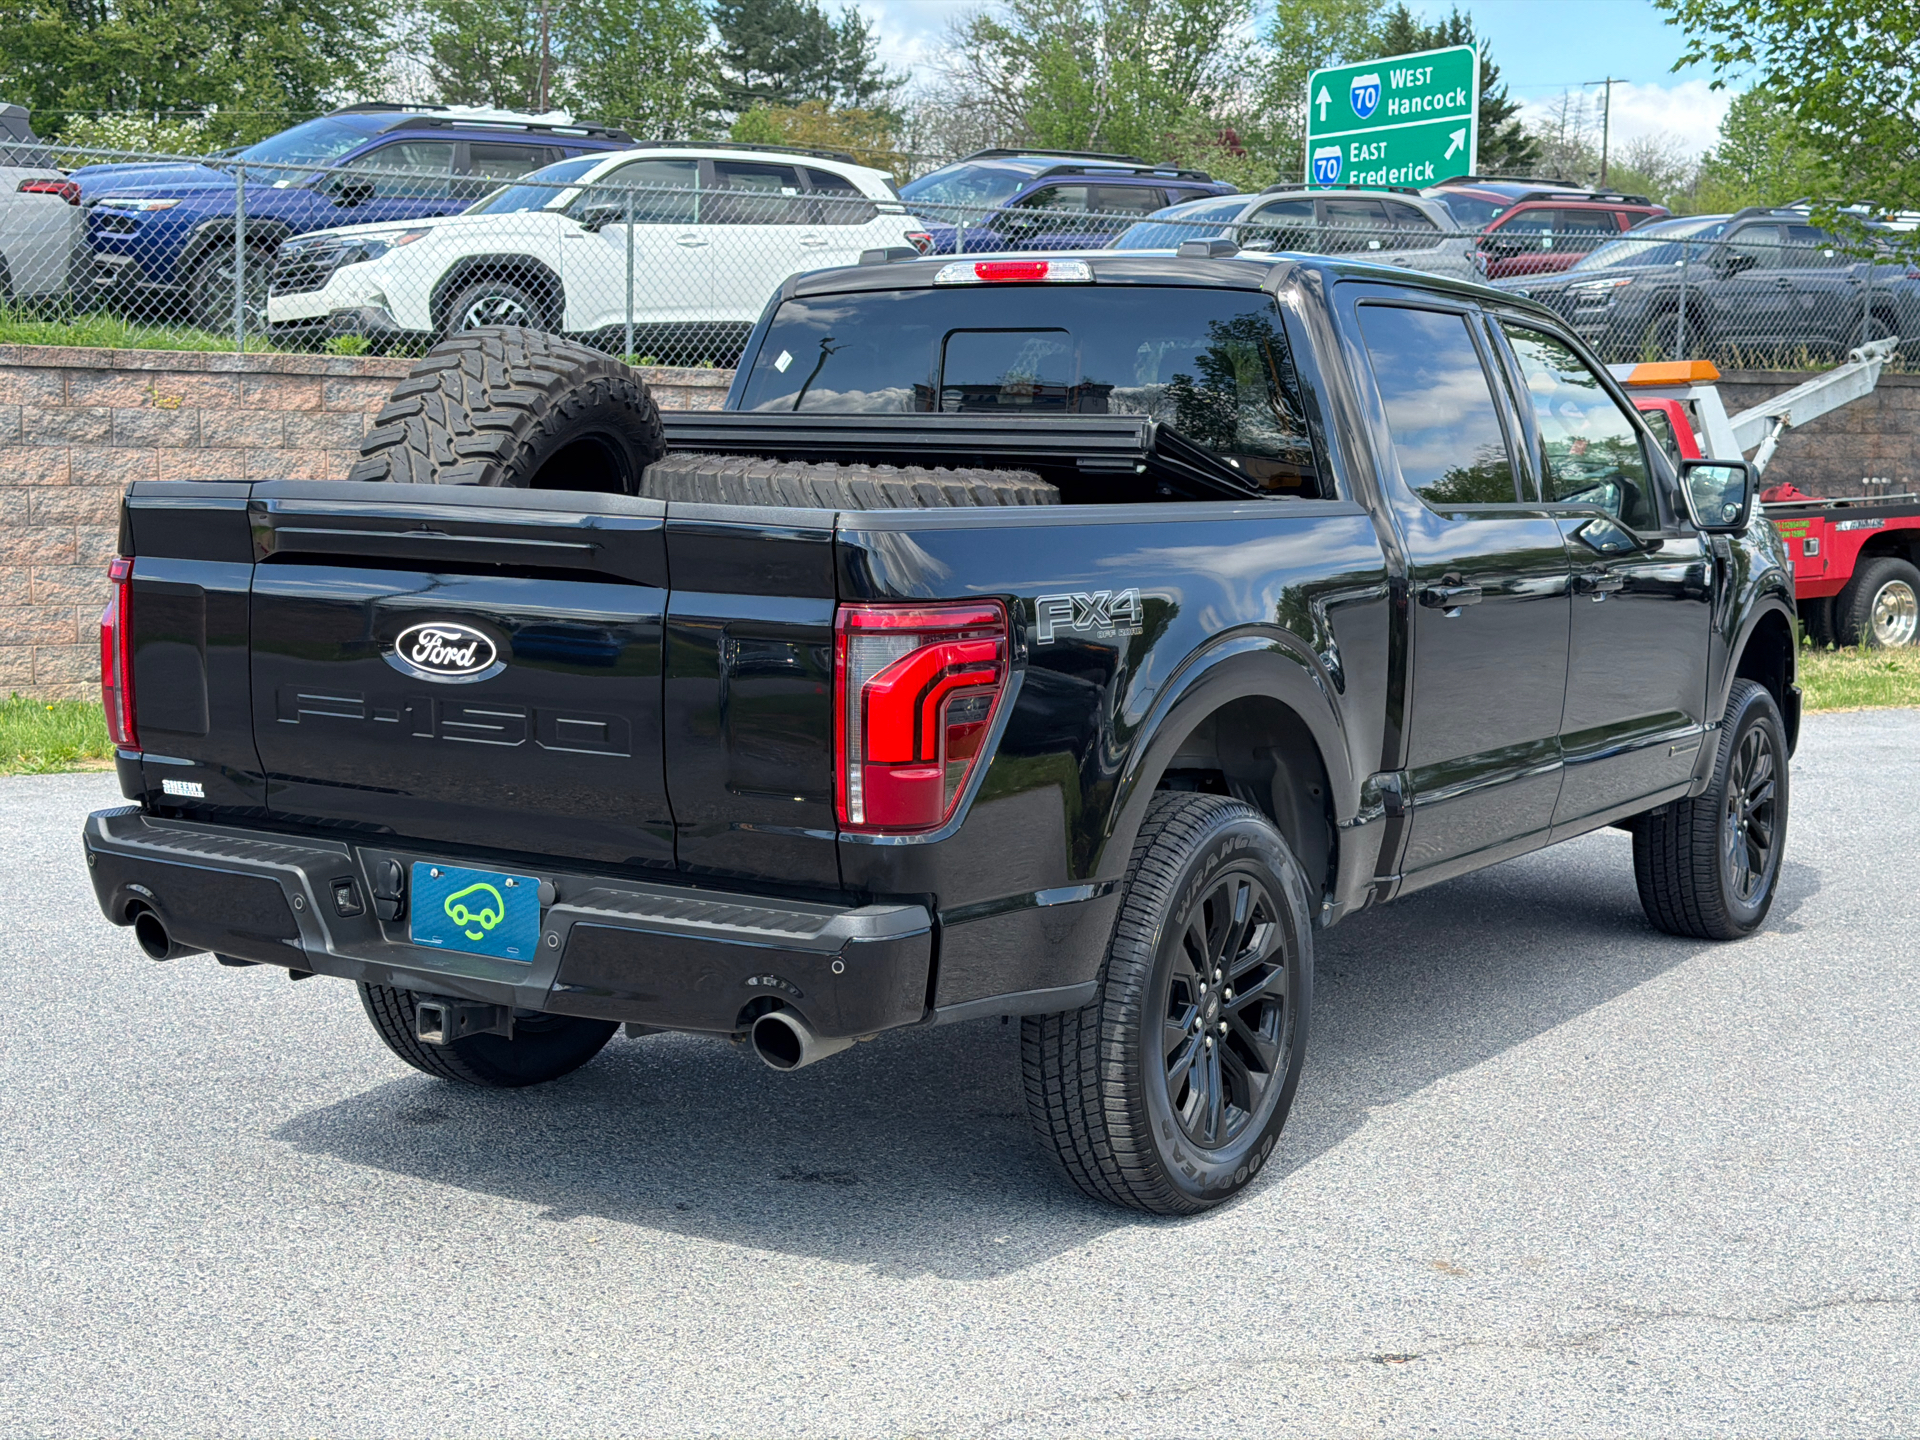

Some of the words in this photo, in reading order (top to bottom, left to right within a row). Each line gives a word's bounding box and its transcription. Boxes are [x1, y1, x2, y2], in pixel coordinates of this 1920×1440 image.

[1355, 87, 1376, 109] 70
[1390, 67, 1433, 89] WEST
[1388, 87, 1466, 116] Hancock
[1317, 159, 1337, 180] 70
[1350, 142, 1387, 162] EAST
[1350, 161, 1434, 185] Frederick
[1035, 588, 1143, 645] FX4
[1097, 629, 1116, 639] OFF
[412, 629, 478, 667] Ford
[275, 684, 631, 757] F-150
[1161, 1118, 1273, 1189] GOODYEAR
